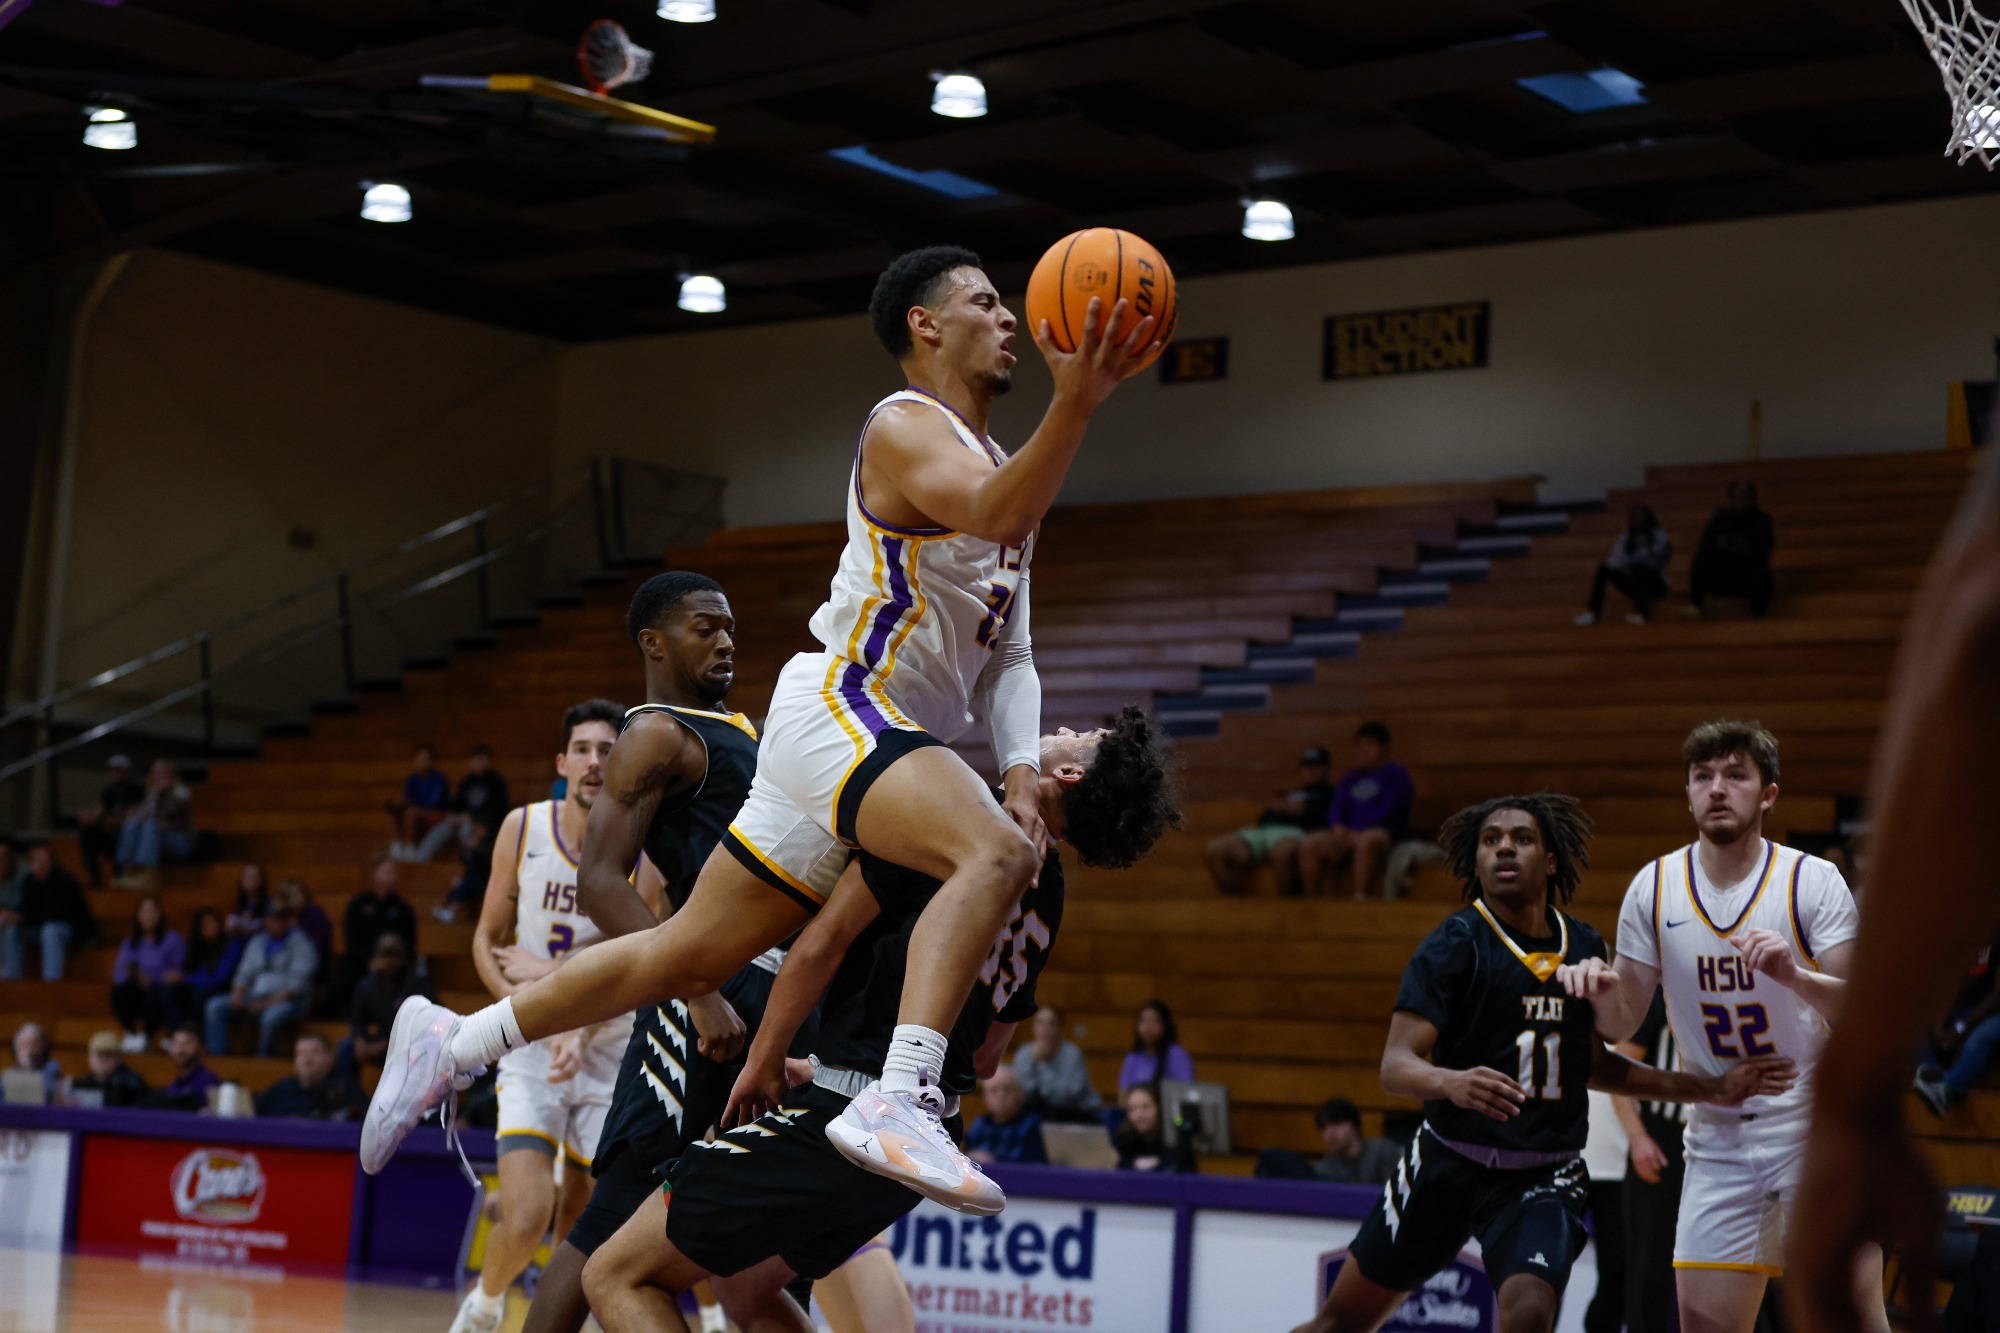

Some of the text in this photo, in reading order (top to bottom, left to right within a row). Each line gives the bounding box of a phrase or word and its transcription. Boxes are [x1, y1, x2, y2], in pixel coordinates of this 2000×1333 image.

[542, 881, 588, 918] HS
[546, 922, 575, 959] 2
[1697, 955, 1756, 993] HSU
[1522, 996, 1564, 1022] TLU
[1701, 1001, 1777, 1059] 22
[1515, 1029, 1563, 1101] 11
